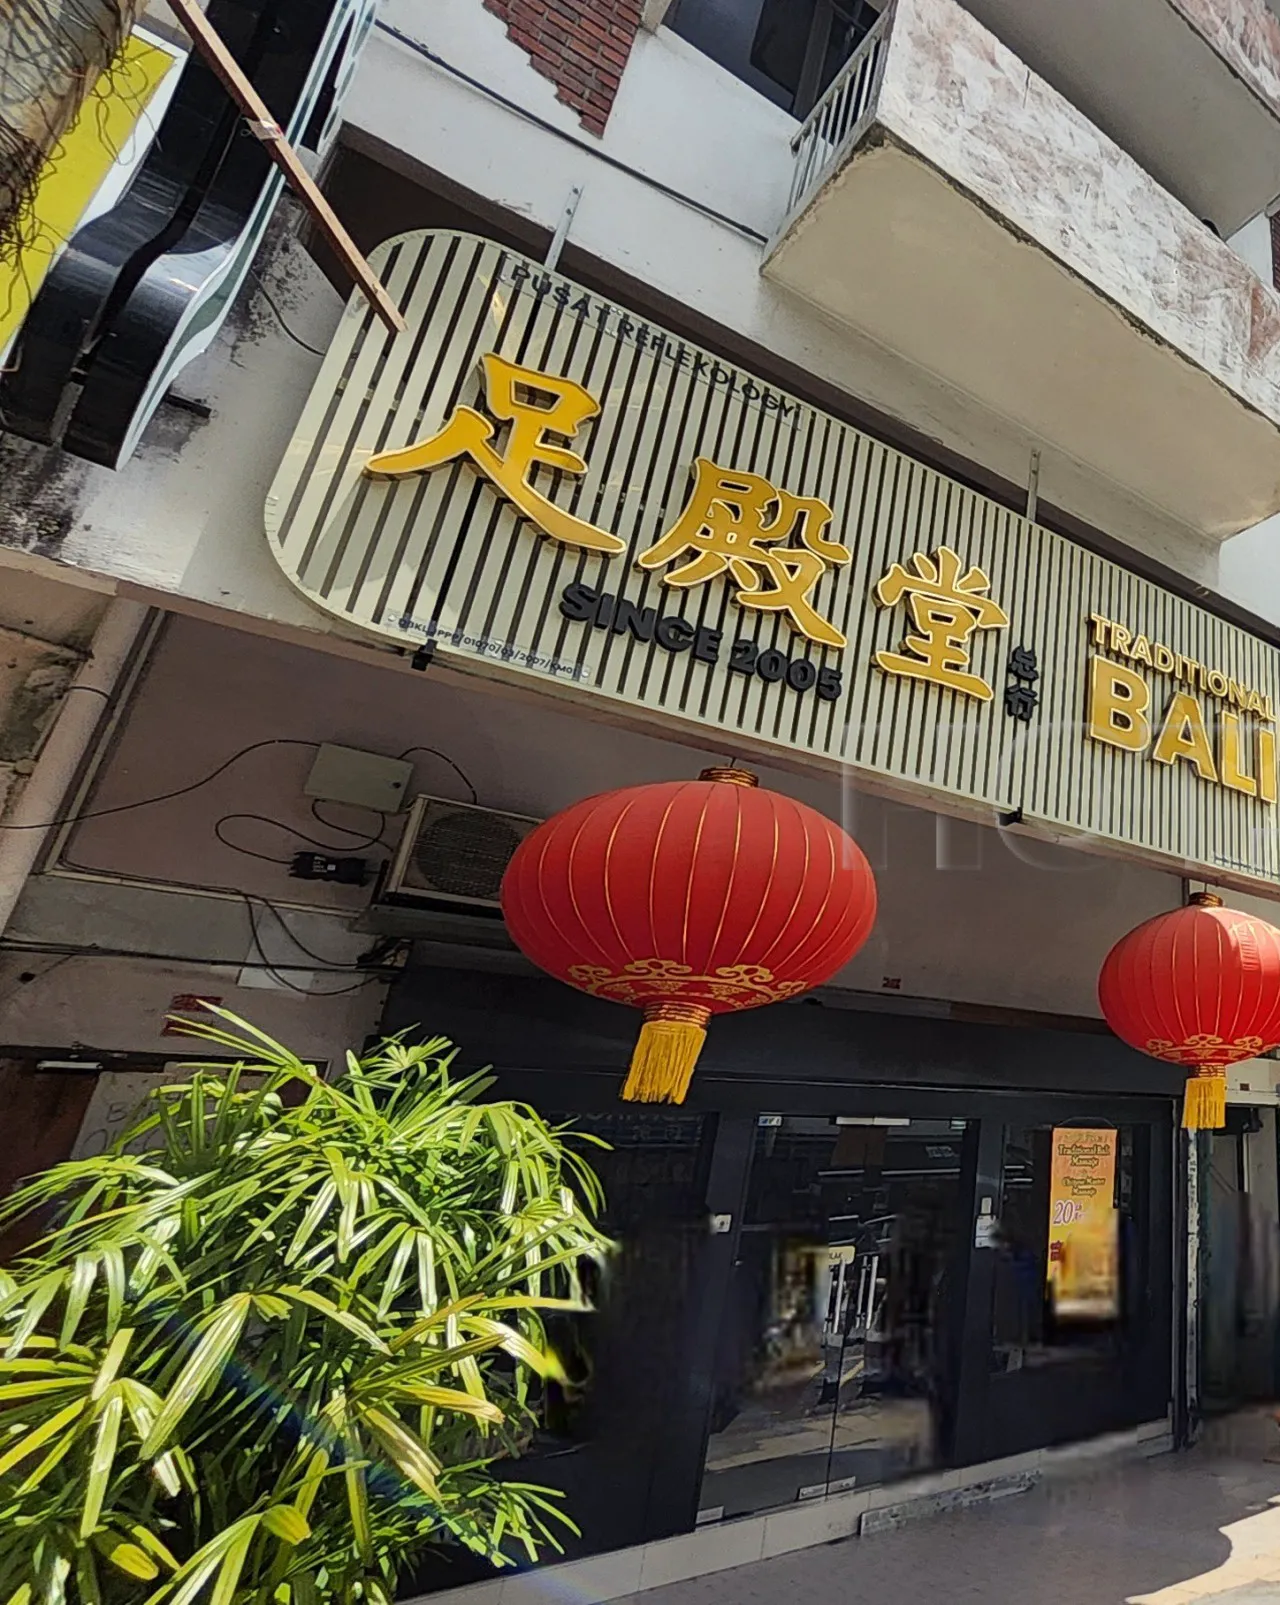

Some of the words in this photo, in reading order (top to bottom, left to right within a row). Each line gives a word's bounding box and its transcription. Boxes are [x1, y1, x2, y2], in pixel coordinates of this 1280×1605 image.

[511, 258, 612, 328] PUSAT
[617, 314, 797, 419] REFLEKOLOGY
[365, 352, 1009, 702] 足殿堂
[558, 581, 723, 665] SINCE
[731, 638, 844, 702] 2005
[1089, 611, 1278, 723] TRADITIONAL
[1089, 654, 1279, 805] BALI
